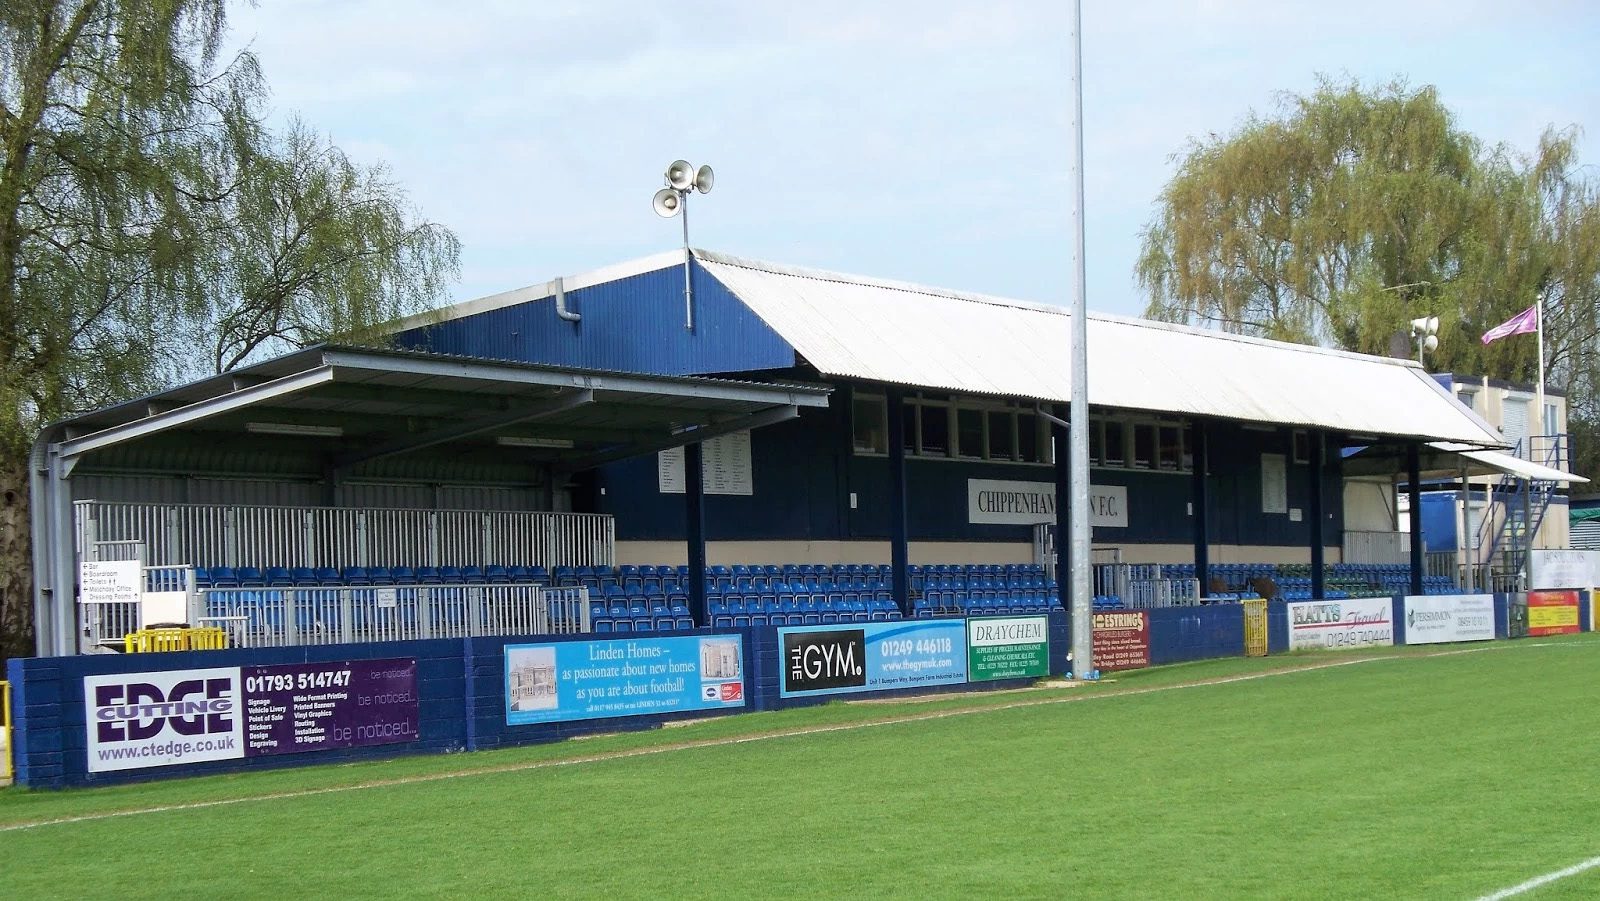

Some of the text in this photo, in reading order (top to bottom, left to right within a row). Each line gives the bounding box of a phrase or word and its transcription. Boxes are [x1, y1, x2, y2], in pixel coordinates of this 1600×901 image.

[1100, 496, 1118, 516] F.C.
[1292, 604, 1340, 624] HATTS
[1346, 606, 1386, 629] Travel
[976, 624, 1041, 640] DRAYCHEM
[590, 644, 624, 660] Linden
[627, 642, 661, 659] Homes
[882, 638, 952, 656] 01249 446118
[562, 658, 696, 684] as passionate about new homes
[792, 645, 802, 680] THE
[882, 658, 952, 672] www.thegymuk.com
[246, 670, 351, 692] 01793 514747
[370, 670, 380, 679] be
[358, 694, 371, 705] be
[576, 678, 685, 703] as you are about football!
[96, 700, 232, 720] CUTTING
[96, 678, 232, 743] EDGE
[294, 702, 313, 710] Printed
[294, 710, 332, 720] Vinyl Graphics
[295, 728, 325, 736] Installation
[334, 723, 352, 740] be
[98, 736, 234, 760] www.ctedge.co.uk
[250, 740, 278, 748] Engraving
